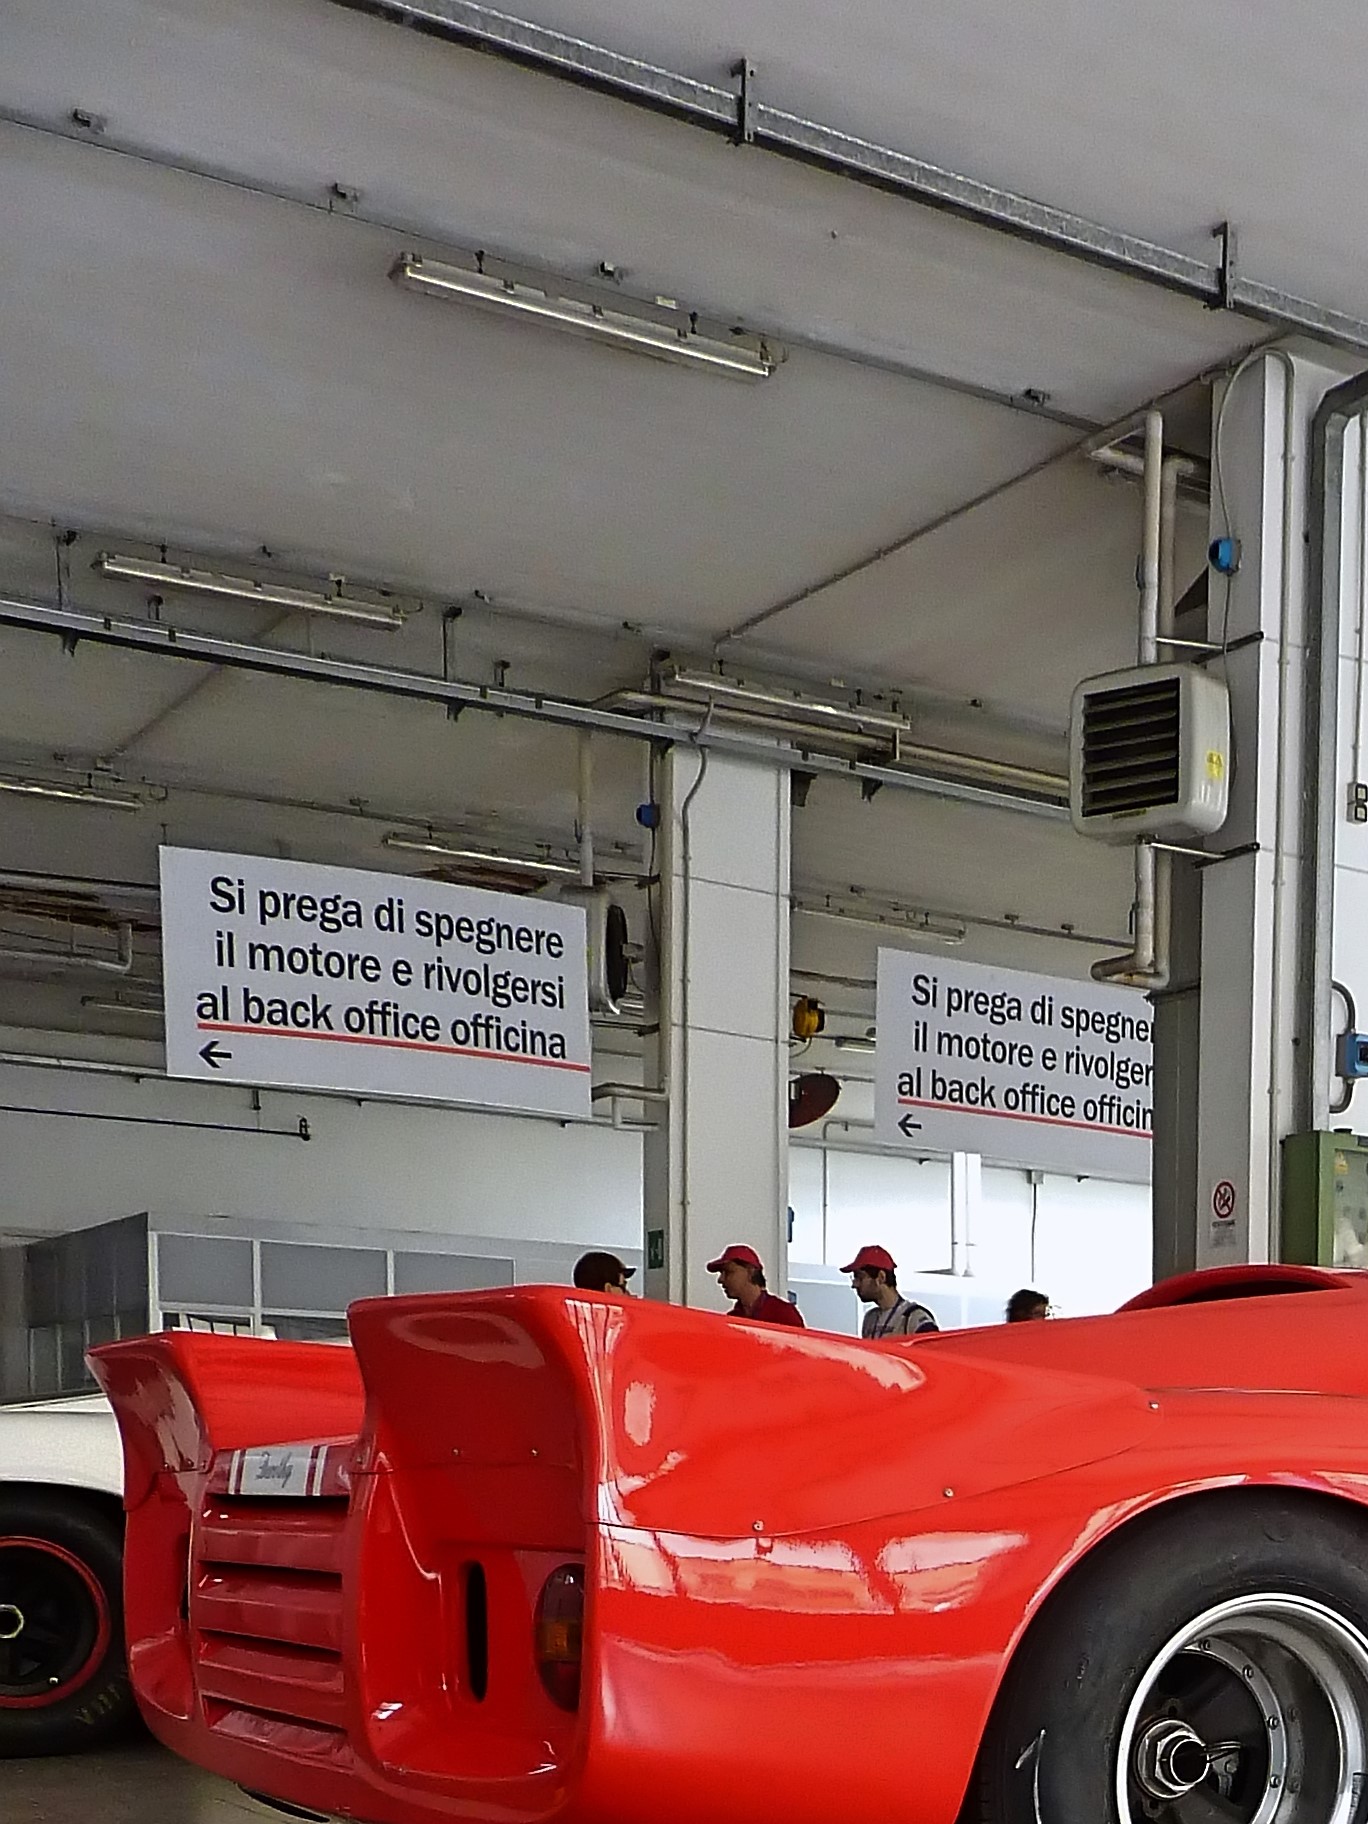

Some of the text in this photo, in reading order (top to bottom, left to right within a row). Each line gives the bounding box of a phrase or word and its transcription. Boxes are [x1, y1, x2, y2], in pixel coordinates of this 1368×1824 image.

[210, 876, 563, 958] Si prega di spegnere
[216, 930, 564, 1009] il motore e rivolgersi
[912, 974, 937, 1008] Si
[947, 986, 1021, 1025] prega
[1031, 995, 1052, 1025] di
[197, 985, 566, 1059] al back office officina
[914, 1020, 927, 1052] il
[937, 1031, 1033, 1067] motore
[1042, 1048, 1056, 1070] e
[898, 1067, 921, 1097] al
[932, 1069, 996, 1108] back
[1004, 1082, 1075, 1118] office
